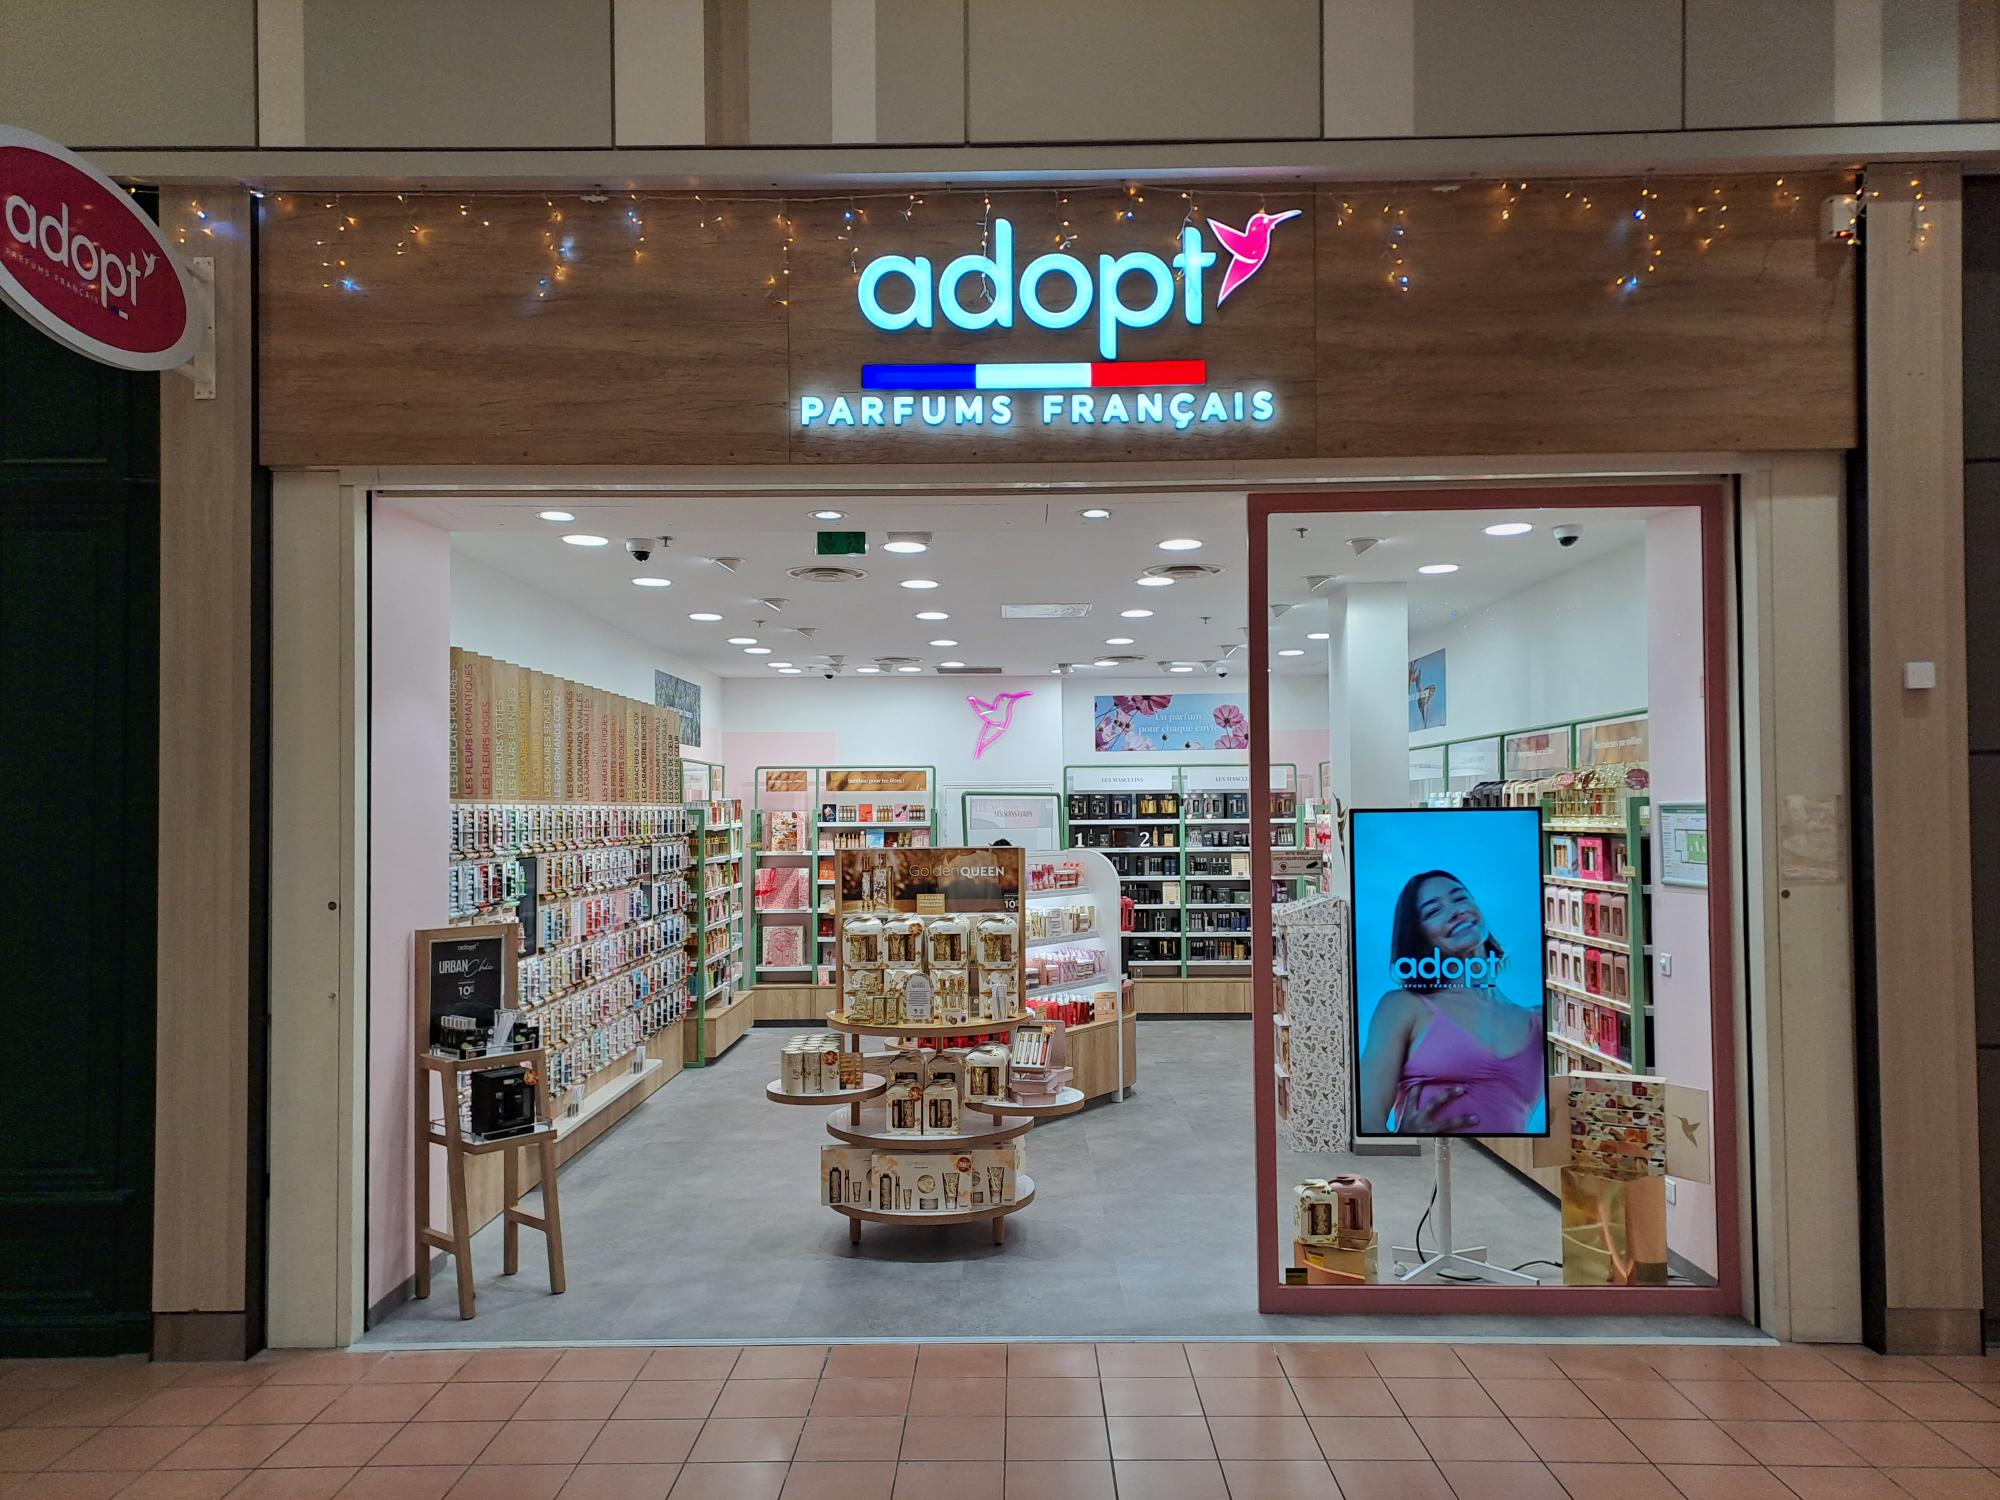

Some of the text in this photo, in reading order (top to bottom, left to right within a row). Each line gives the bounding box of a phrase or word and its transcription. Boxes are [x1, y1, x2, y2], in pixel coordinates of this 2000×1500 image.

[5, 195, 141, 308] adopt
[857, 218, 1217, 359] adopt
[801, 390, 1275, 429] PARFUMS FRANÇAIS
[464, 664, 473, 795] LES FLEURS ROMANTIQUES
[482, 702, 490, 795] LES FLEURS ROSES
[496, 699, 504, 797] LES FLEURS VERTES
[508, 688, 516, 796] LES FLEURS BLANCHES
[544, 689, 552, 798] LES SOLAIRES SENSUELS
[1138, 726, 1160, 735] pour
[1161, 724, 1192, 734] chaque
[1156, 711, 1202, 723] Un parfum
[1074, 832, 1086, 848] 1
[1139, 832, 1151, 847] 2
[438, 959, 468, 974] URBAN
[1394, 947, 1500, 988] adopt
